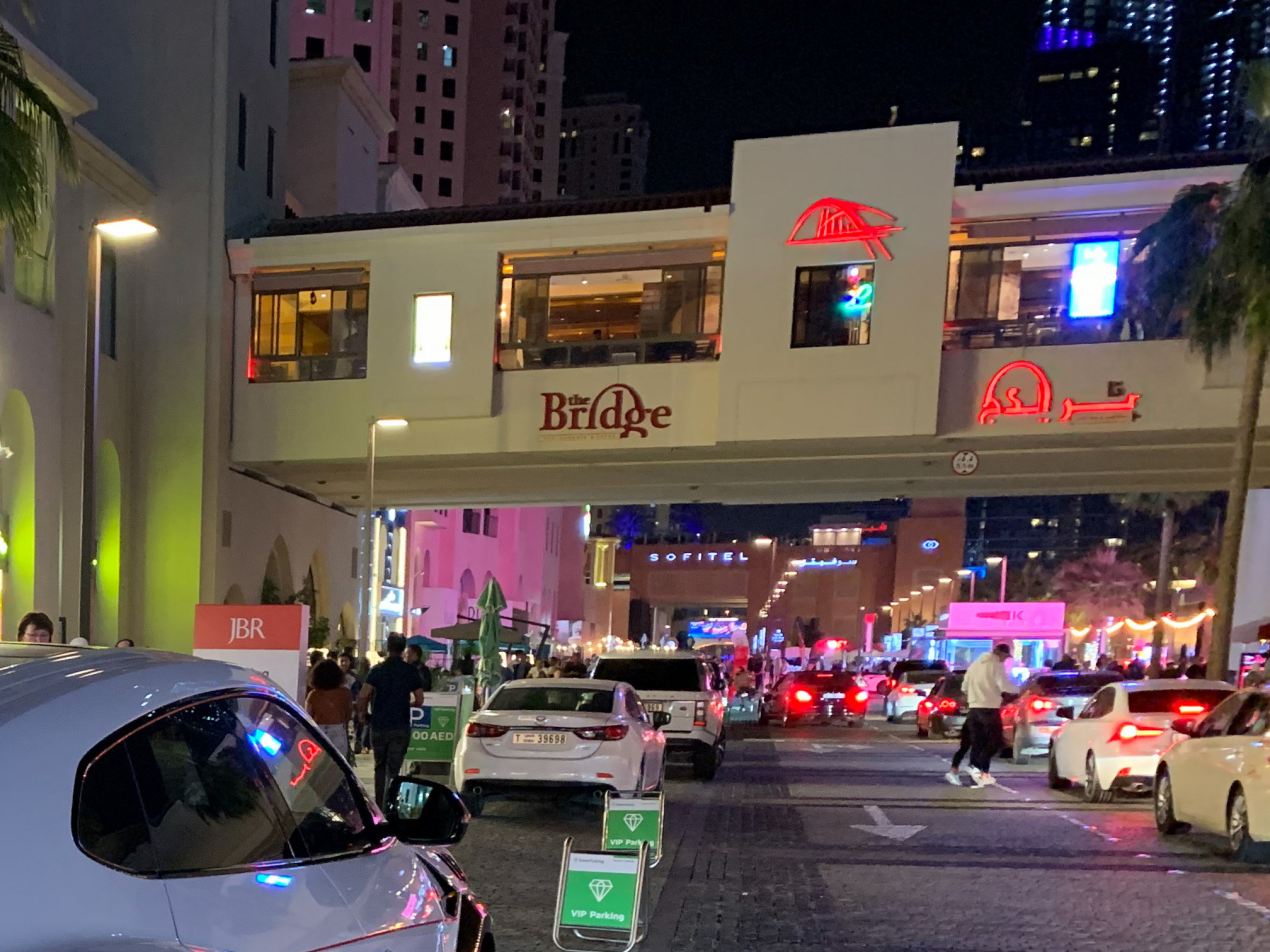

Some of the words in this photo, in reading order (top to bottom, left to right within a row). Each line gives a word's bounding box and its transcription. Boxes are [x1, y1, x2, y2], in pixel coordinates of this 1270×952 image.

[568, 394, 591, 406] the
[539, 383, 673, 439] Bridge
[650, 552, 748, 562] SOFITEL
[228, 617, 265, 645] JBR
[410, 707, 424, 727] P
[430, 731, 454, 741] AED
[537, 734, 566, 744] 39698
[571, 909, 587, 918] VIP
[589, 910, 625, 922] Parking
